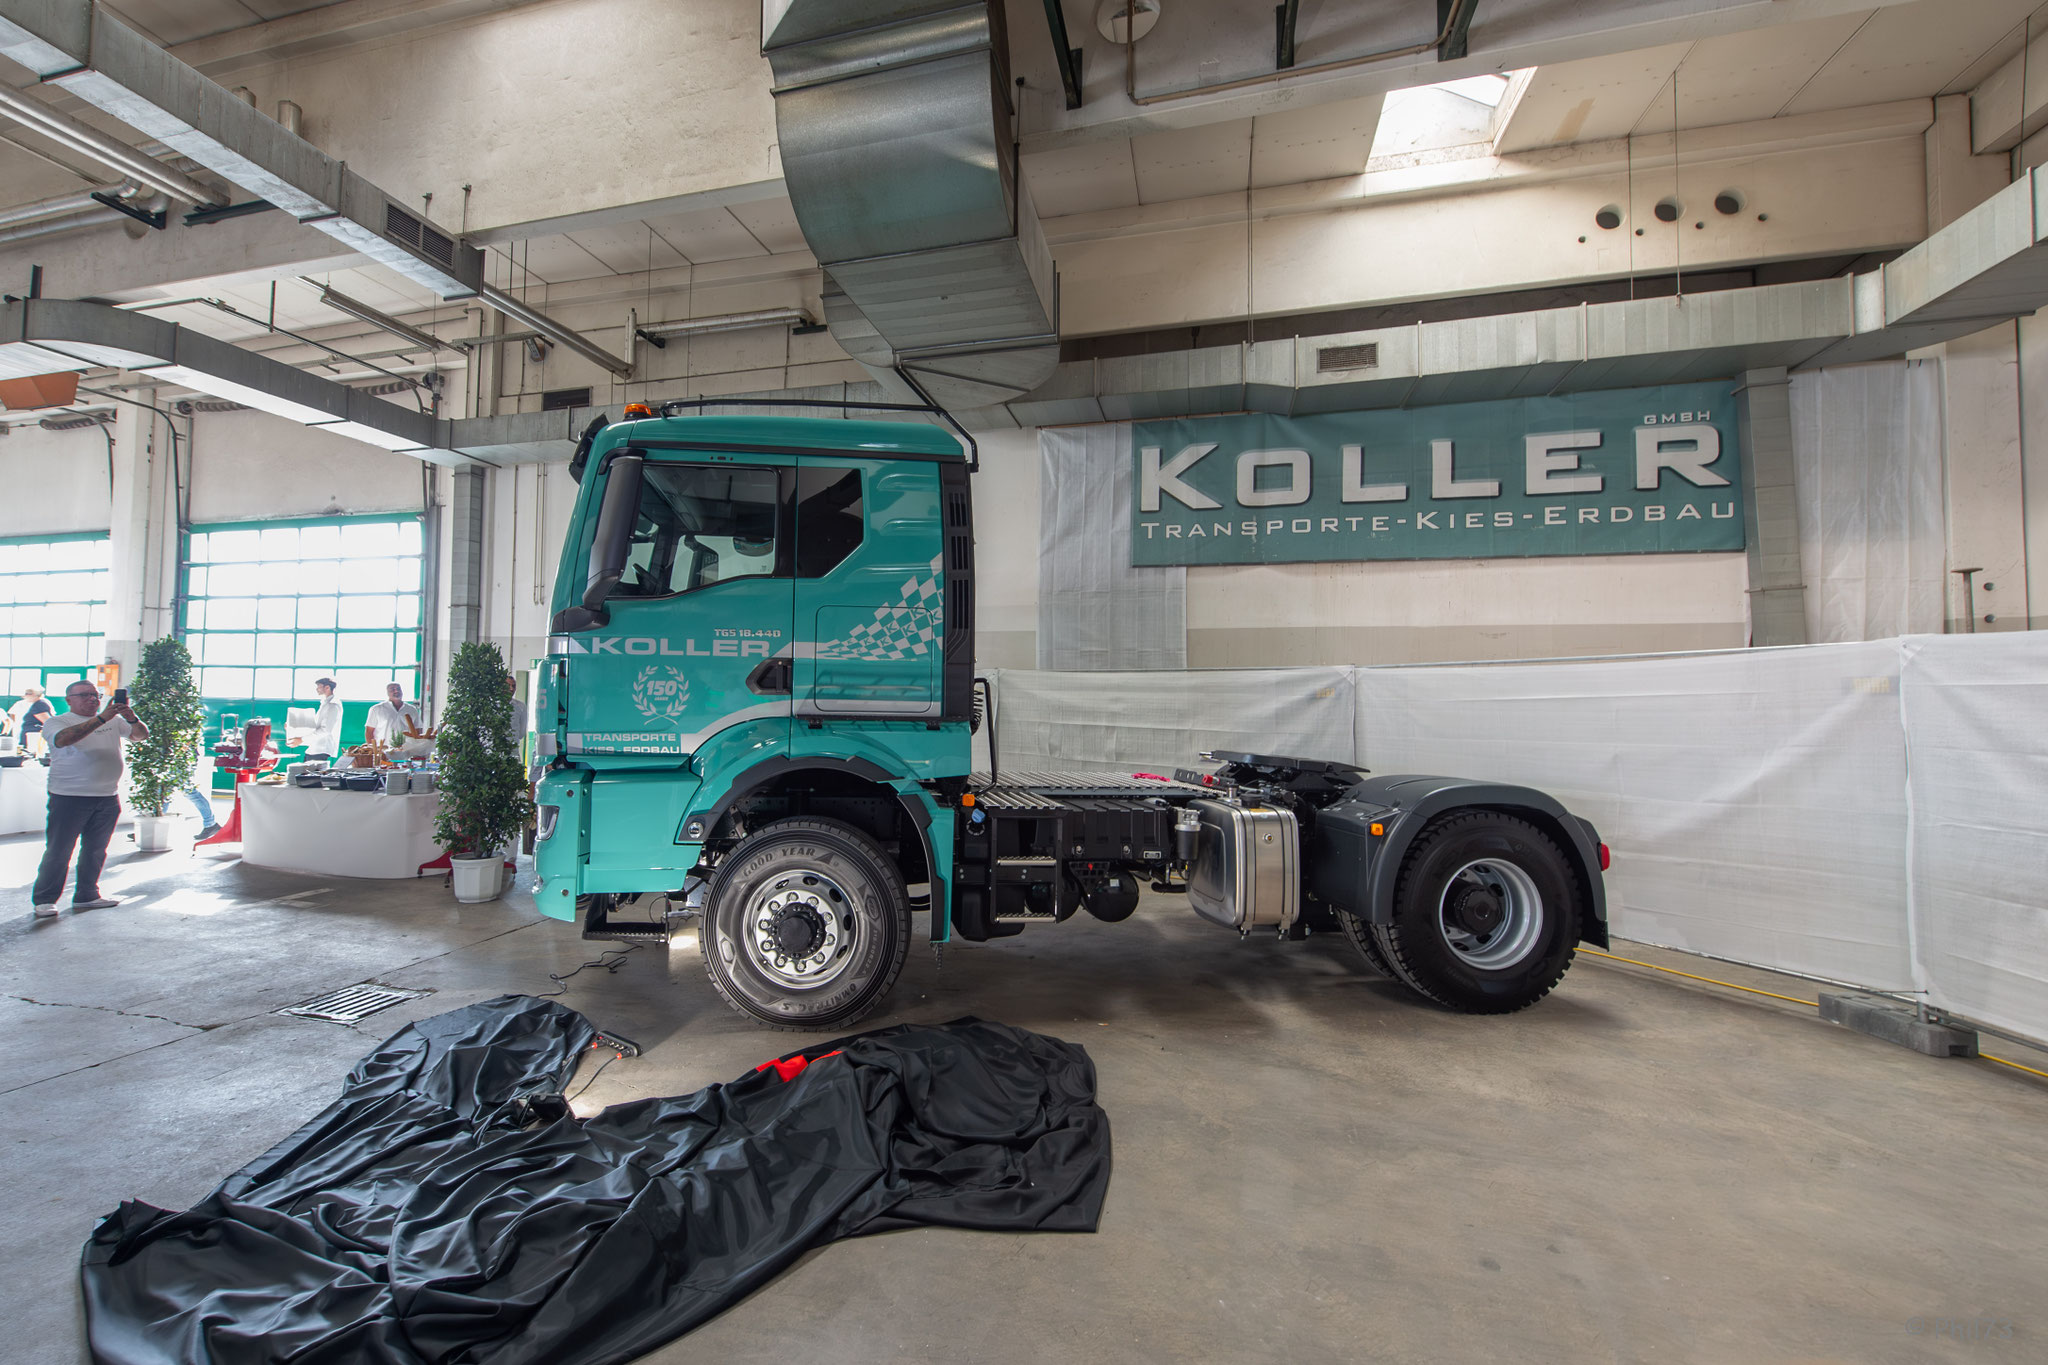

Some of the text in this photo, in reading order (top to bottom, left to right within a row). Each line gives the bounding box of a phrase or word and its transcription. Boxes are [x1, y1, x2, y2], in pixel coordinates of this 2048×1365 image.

[1643, 410, 1711, 425] GMBH
[1140, 424, 1732, 512] KOLLER
[714, 628, 782, 638] TGS 18.440
[592, 636, 770, 658] KOLLER
[646, 680, 678, 696] 150
[584, 733, 676, 742] TRANSPORTE
[781, 847, 816, 857] YEAR
